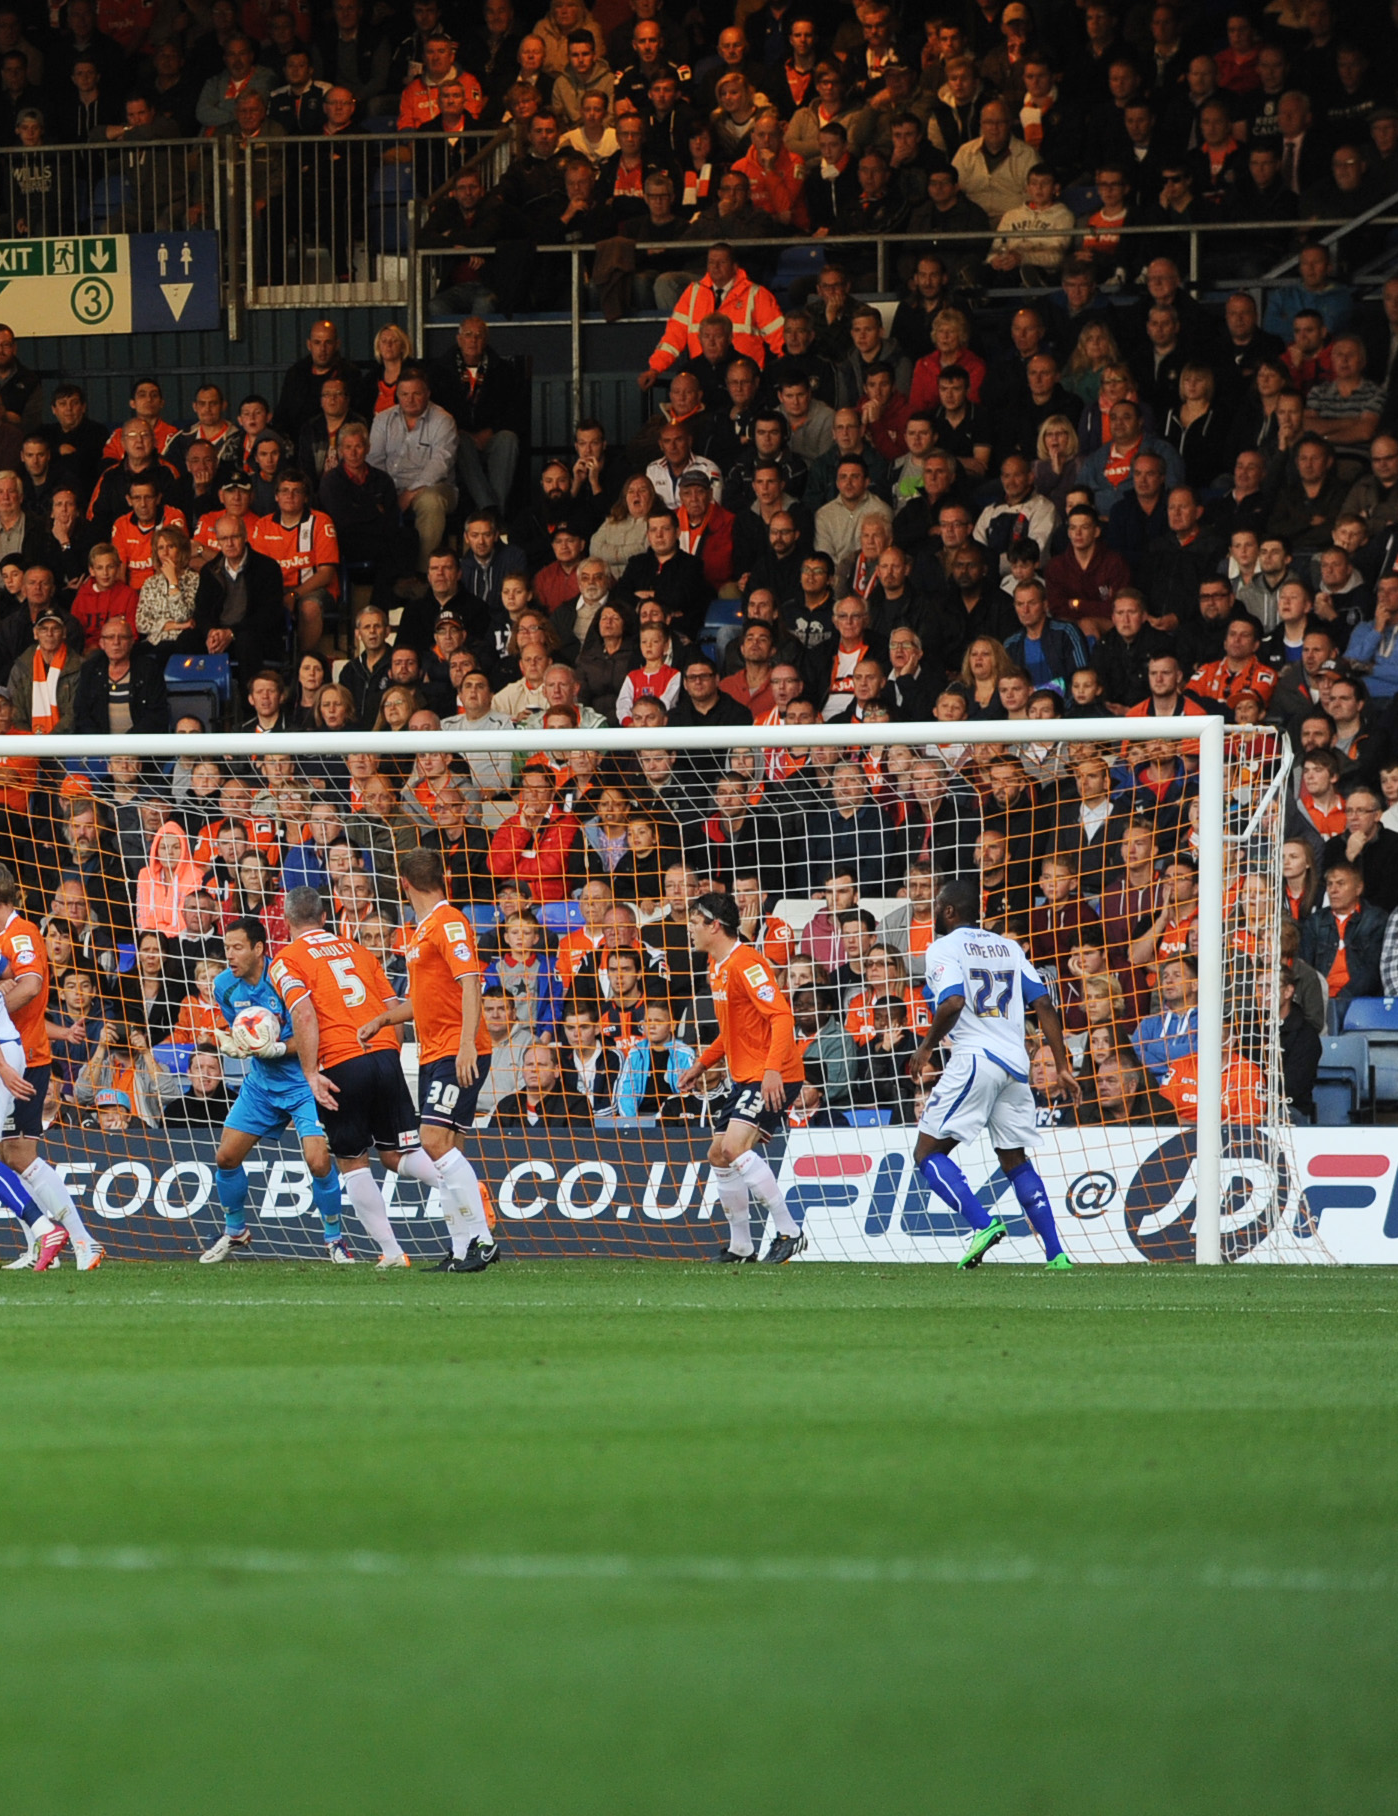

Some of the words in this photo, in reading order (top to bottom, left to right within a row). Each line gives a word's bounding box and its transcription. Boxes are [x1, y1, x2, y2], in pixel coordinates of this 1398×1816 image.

[84, 284, 101, 318] 3
[307, 942, 356, 960] McNULTY
[327, 956, 366, 1008] 5
[969, 968, 1015, 1020] 27
[426, 1081, 460, 1109] 30
[735, 1089, 766, 1114] 23
